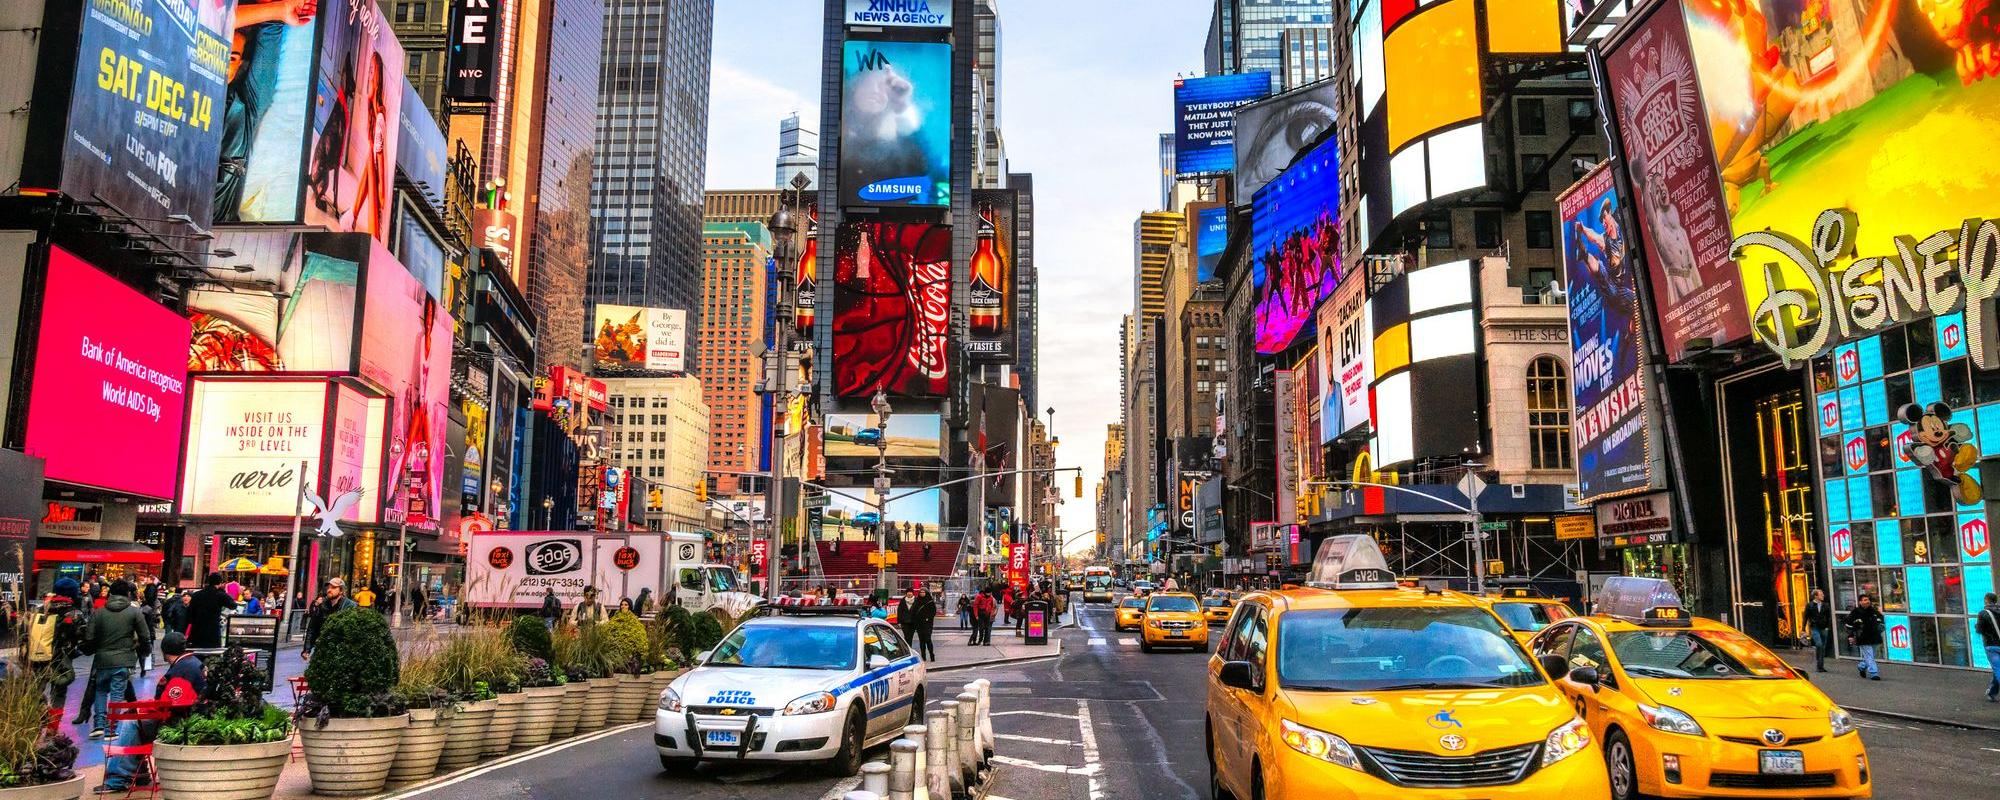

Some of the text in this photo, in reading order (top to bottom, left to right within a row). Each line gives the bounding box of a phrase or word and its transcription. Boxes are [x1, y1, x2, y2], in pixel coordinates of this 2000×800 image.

[868, 0, 930, 13] XINHUA
[854, 12, 944, 24] NEWS AGENCY
[459, 70, 483, 78] NYC
[98, 47, 142, 104] SAT.
[147, 70, 186, 122] DEC.
[189, 91, 212, 132] 14
[1184, 113, 1217, 121] MATILDA
[1189, 120, 1229, 130] THEY JUST
[1188, 131, 1213, 140] KNOW
[126, 134, 145, 162] LIVE
[146, 156, 157, 172] ON
[157, 151, 178, 189] FOX
[868, 184, 921, 195] SAMSUNG
[1512, 329, 1537, 340] THE
[1341, 317, 1361, 368] LEVI
[81, 336, 183, 395] Bank of America recognizes
[1575, 338, 1613, 396] MOVES
[102, 381, 162, 422] World AIDS Day.
[244, 412, 292, 423] VISIT US
[225, 426, 308, 438] INSIDE ON THE
[239, 440, 292, 451] 3RD LEVEL
[1602, 438, 1614, 454] ON
[229, 463, 294, 490] aerie
[1614, 501, 1654, 521] DIGITAL
[1649, 534, 1667, 543] SONY
[1964, 527, 1986, 551] IN
[537, 549, 571, 566] edge
[1014, 545, 1023, 569] tkts
[520, 578, 585, 587] (212) 947-3343
[1656, 608, 1678, 618] 7L66
[869, 679, 889, 707] NYPD
[707, 696, 756, 705] POLICE
[708, 731, 732, 742] 4135
